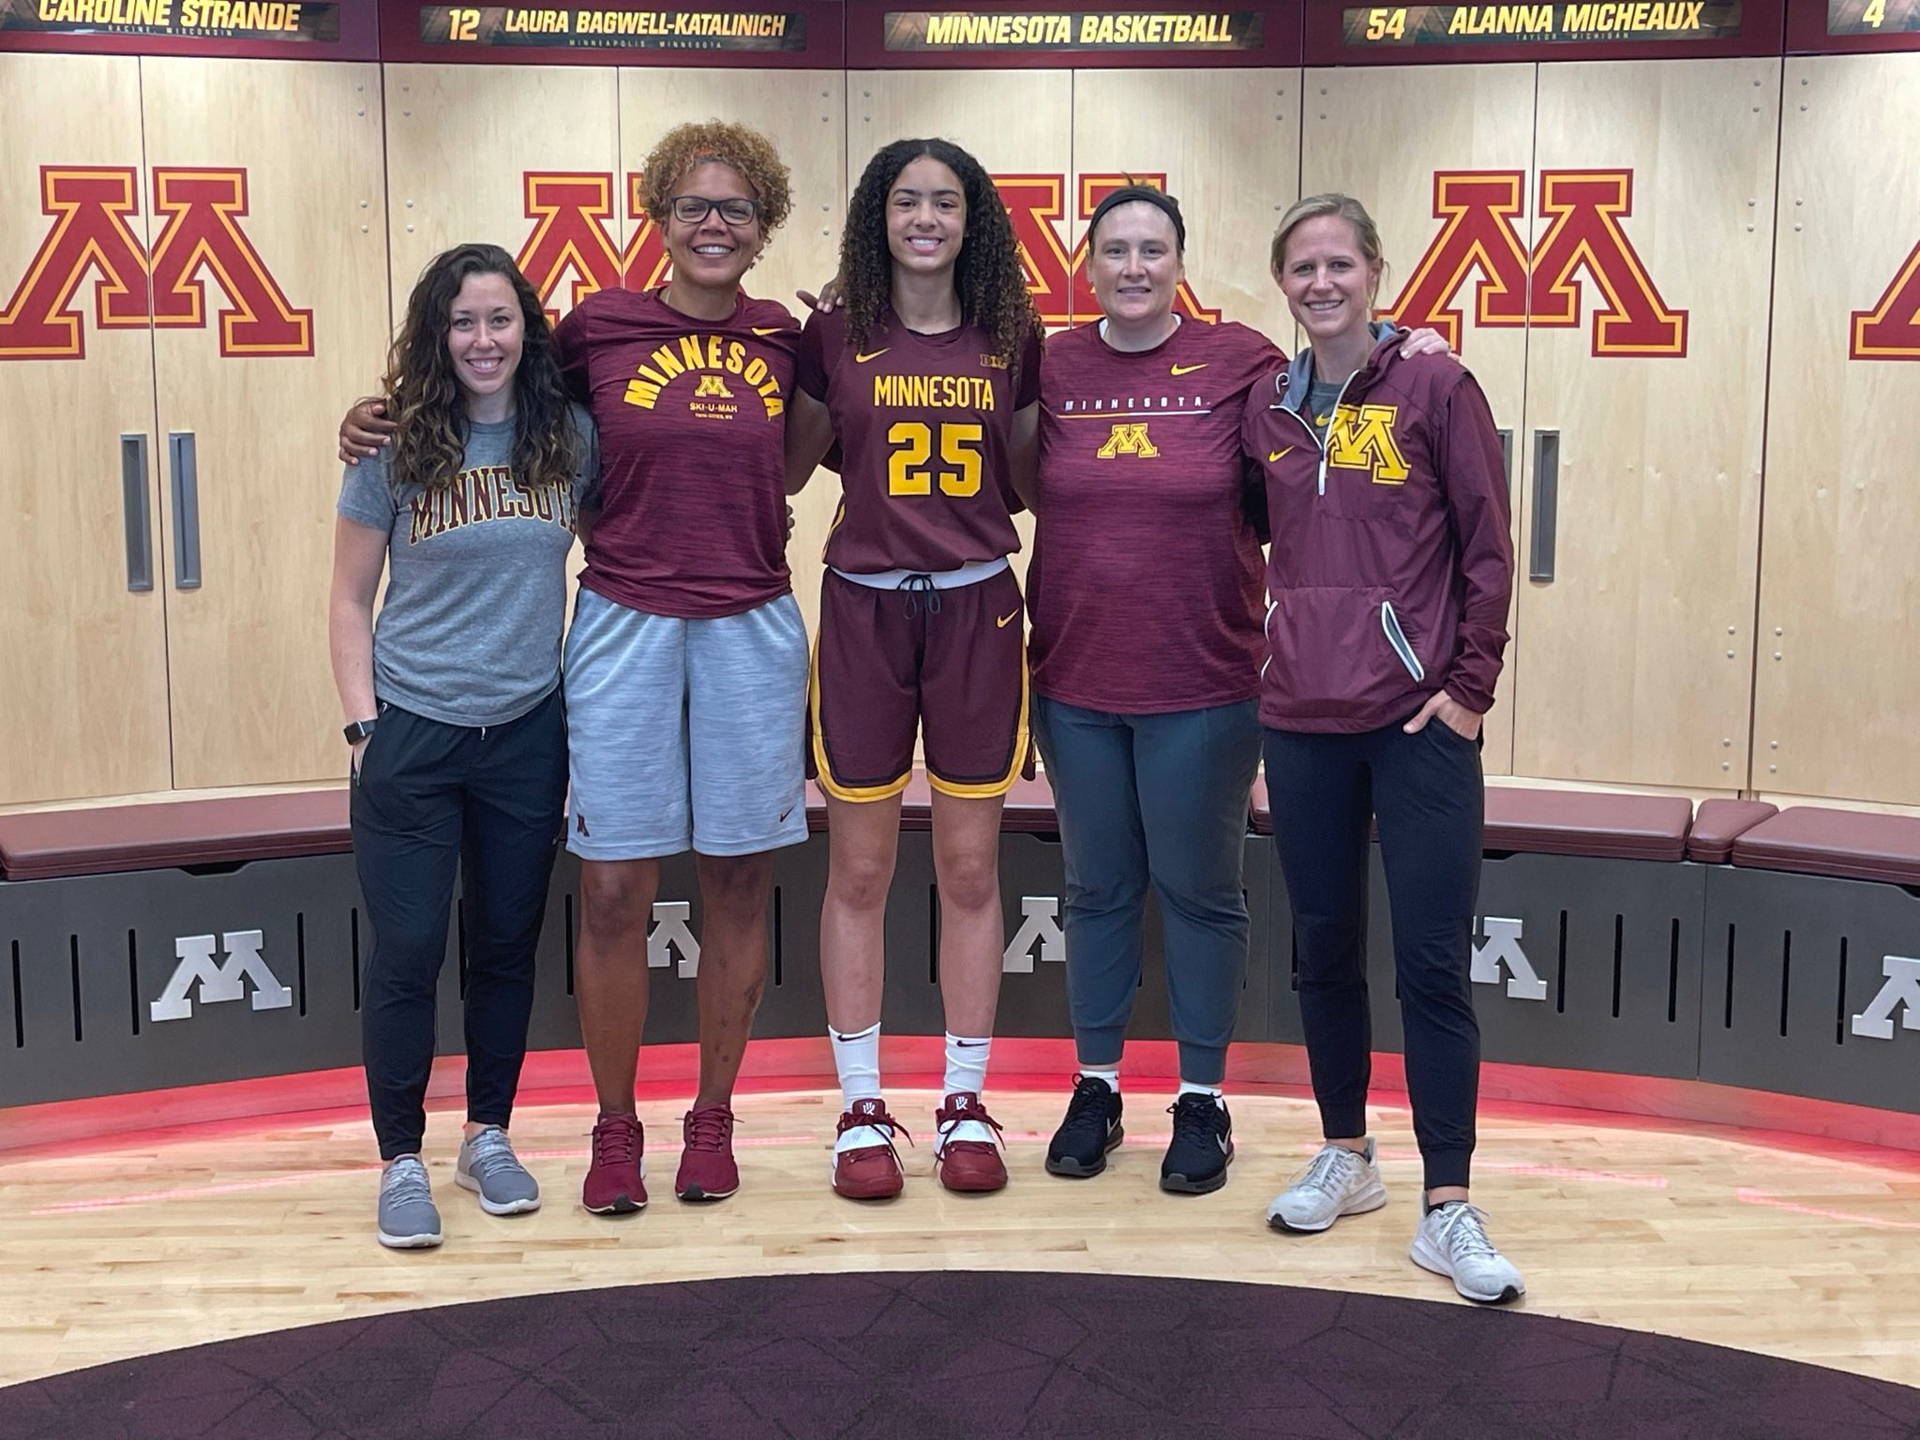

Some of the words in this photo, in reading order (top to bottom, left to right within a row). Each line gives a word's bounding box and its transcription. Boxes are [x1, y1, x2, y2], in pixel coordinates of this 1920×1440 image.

[38, 0, 171, 26] CAROLINE
[181, 0, 300, 31] STRANDE
[448, 9, 480, 41] 12
[505, 10, 569, 34] LAURA
[576, 10, 786, 37] BAGWELL-KATALINICH
[926, 15, 1072, 44] MINNESOTA
[1080, 14, 1233, 43] BASKETBALL
[1366, 8, 1407, 40] 54
[1448, 5, 1553, 34] ALANNA
[1562, 1, 1705, 32] MICHEAUX
[1862, 0, 1886, 28] 4
[623, 334, 785, 418] MINNESOTA
[874, 375, 995, 411] MINNESOTA
[1065, 396, 1202, 411] MINNESOTA
[887, 422, 984, 498] 25
